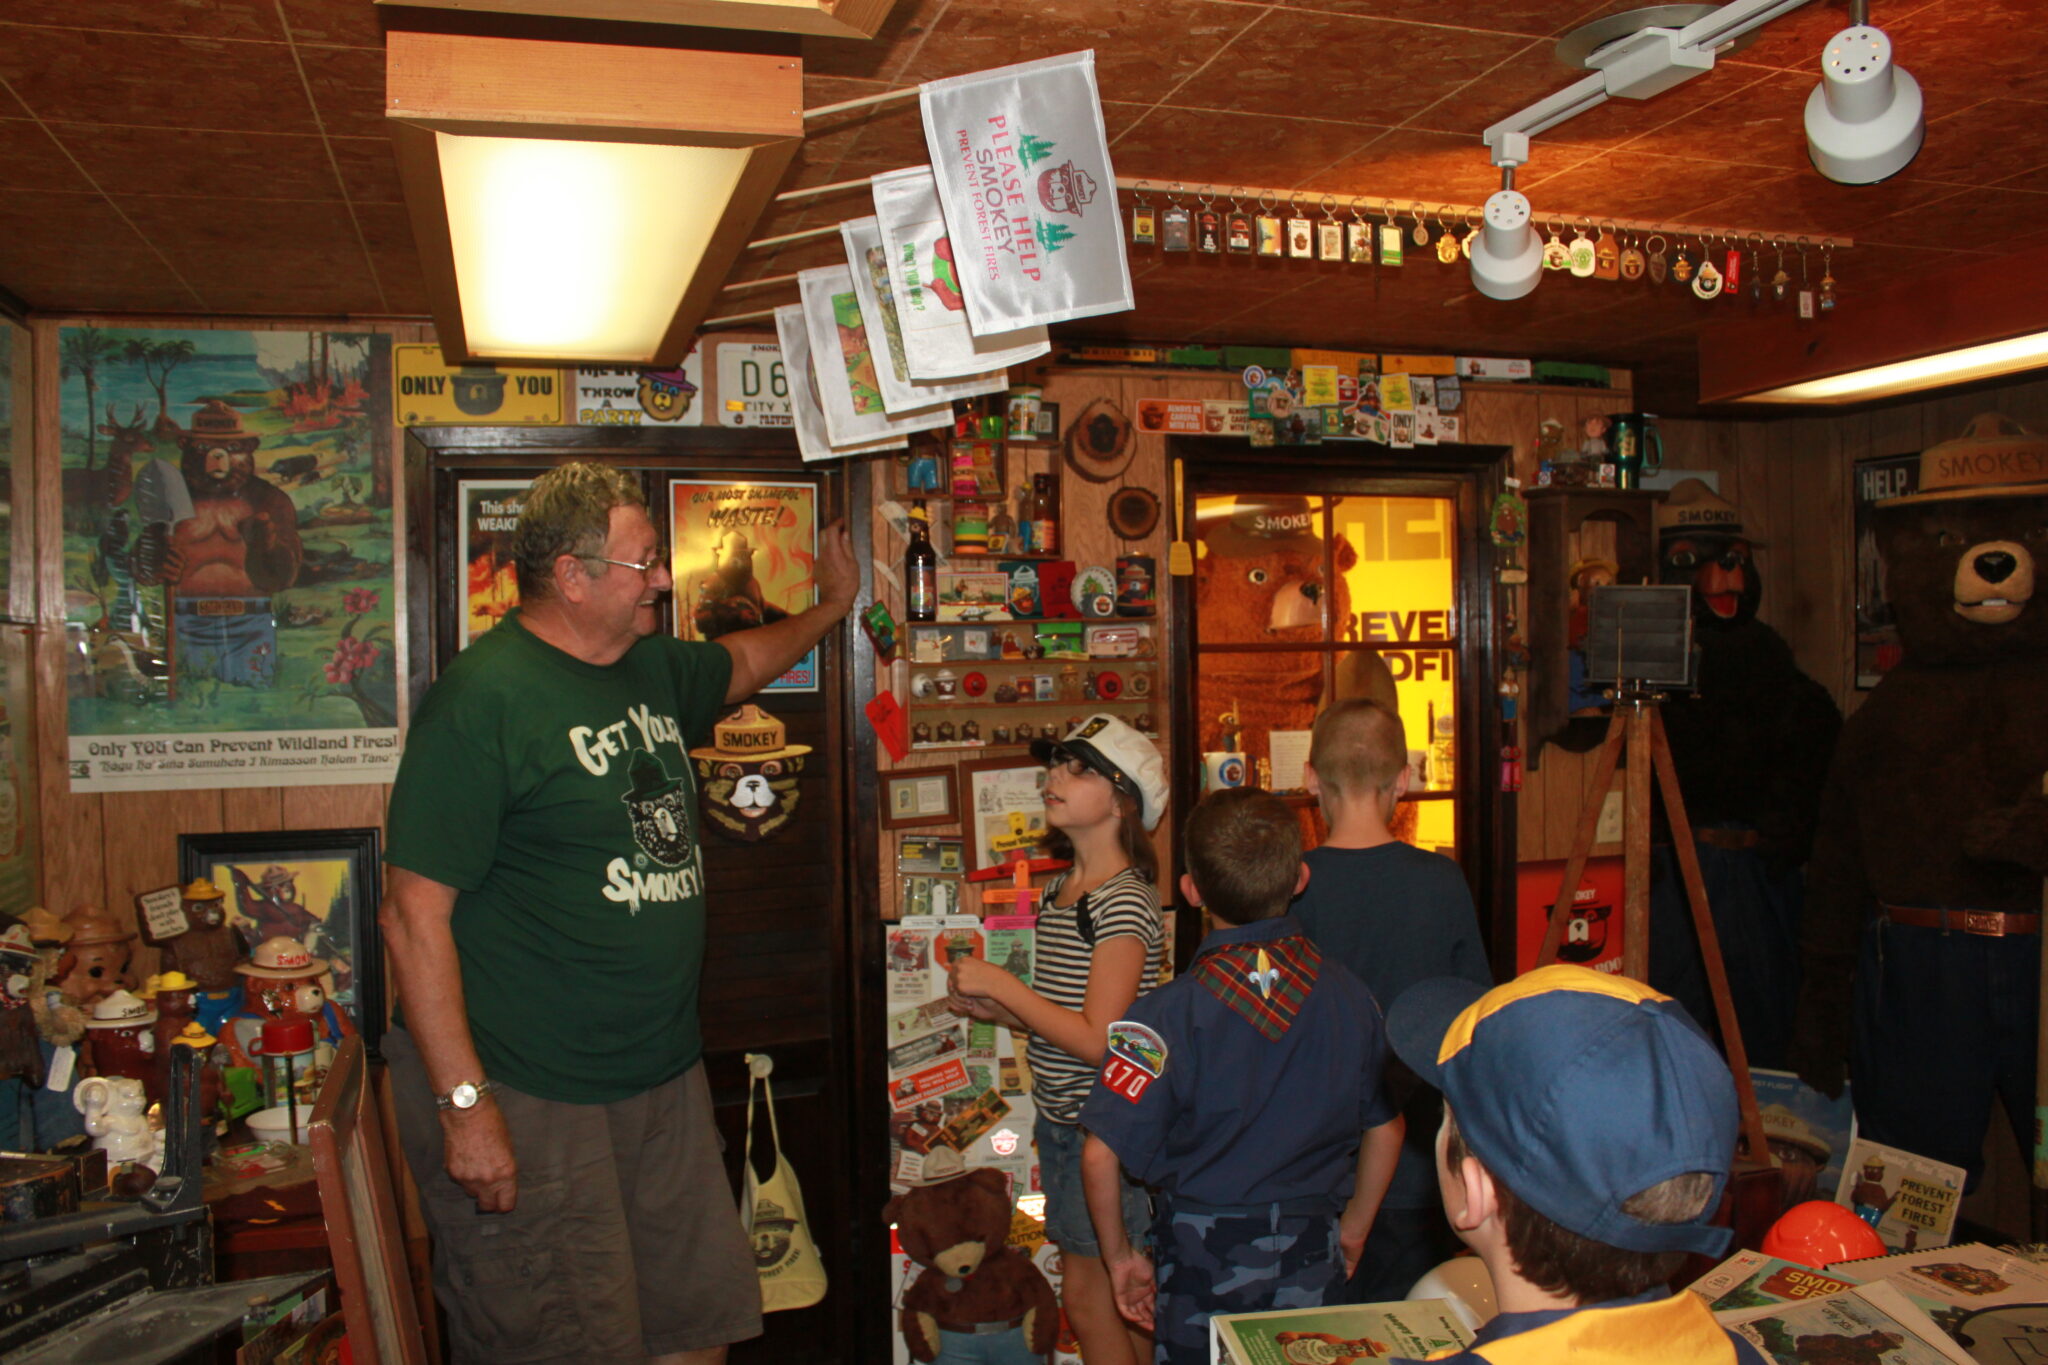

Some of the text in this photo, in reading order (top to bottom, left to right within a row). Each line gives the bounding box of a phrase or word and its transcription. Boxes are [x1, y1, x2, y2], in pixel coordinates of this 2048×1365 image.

[956, 129, 1000, 281] PREVENT FOREST FIRES
[976, 149, 1015, 254] SMOKEY
[988, 115, 1041, 281] PLEASE HELP
[401, 376, 553, 396] ONLY YOU
[580, 387, 637, 398] THROW
[580, 408, 644, 424] PARTY
[1938, 452, 2047, 479] SMOKEY
[480, 500, 504, 514] This
[692, 491, 714, 504] OUR
[716, 489, 746, 502] MOST
[706, 505, 785, 529] WASTE!
[1678, 509, 1736, 524] SMOKEY
[89, 734, 398, 757] Only YOU Can Prevent Wildland Fires!
[722, 730, 779, 749] SMOKEY
[1104, 1061, 1148, 1097] 470
[1901, 1179, 1952, 1201] PREVENT
[1901, 1193, 1945, 1214] FOREST
[1902, 1208, 1936, 1227] FIRES
